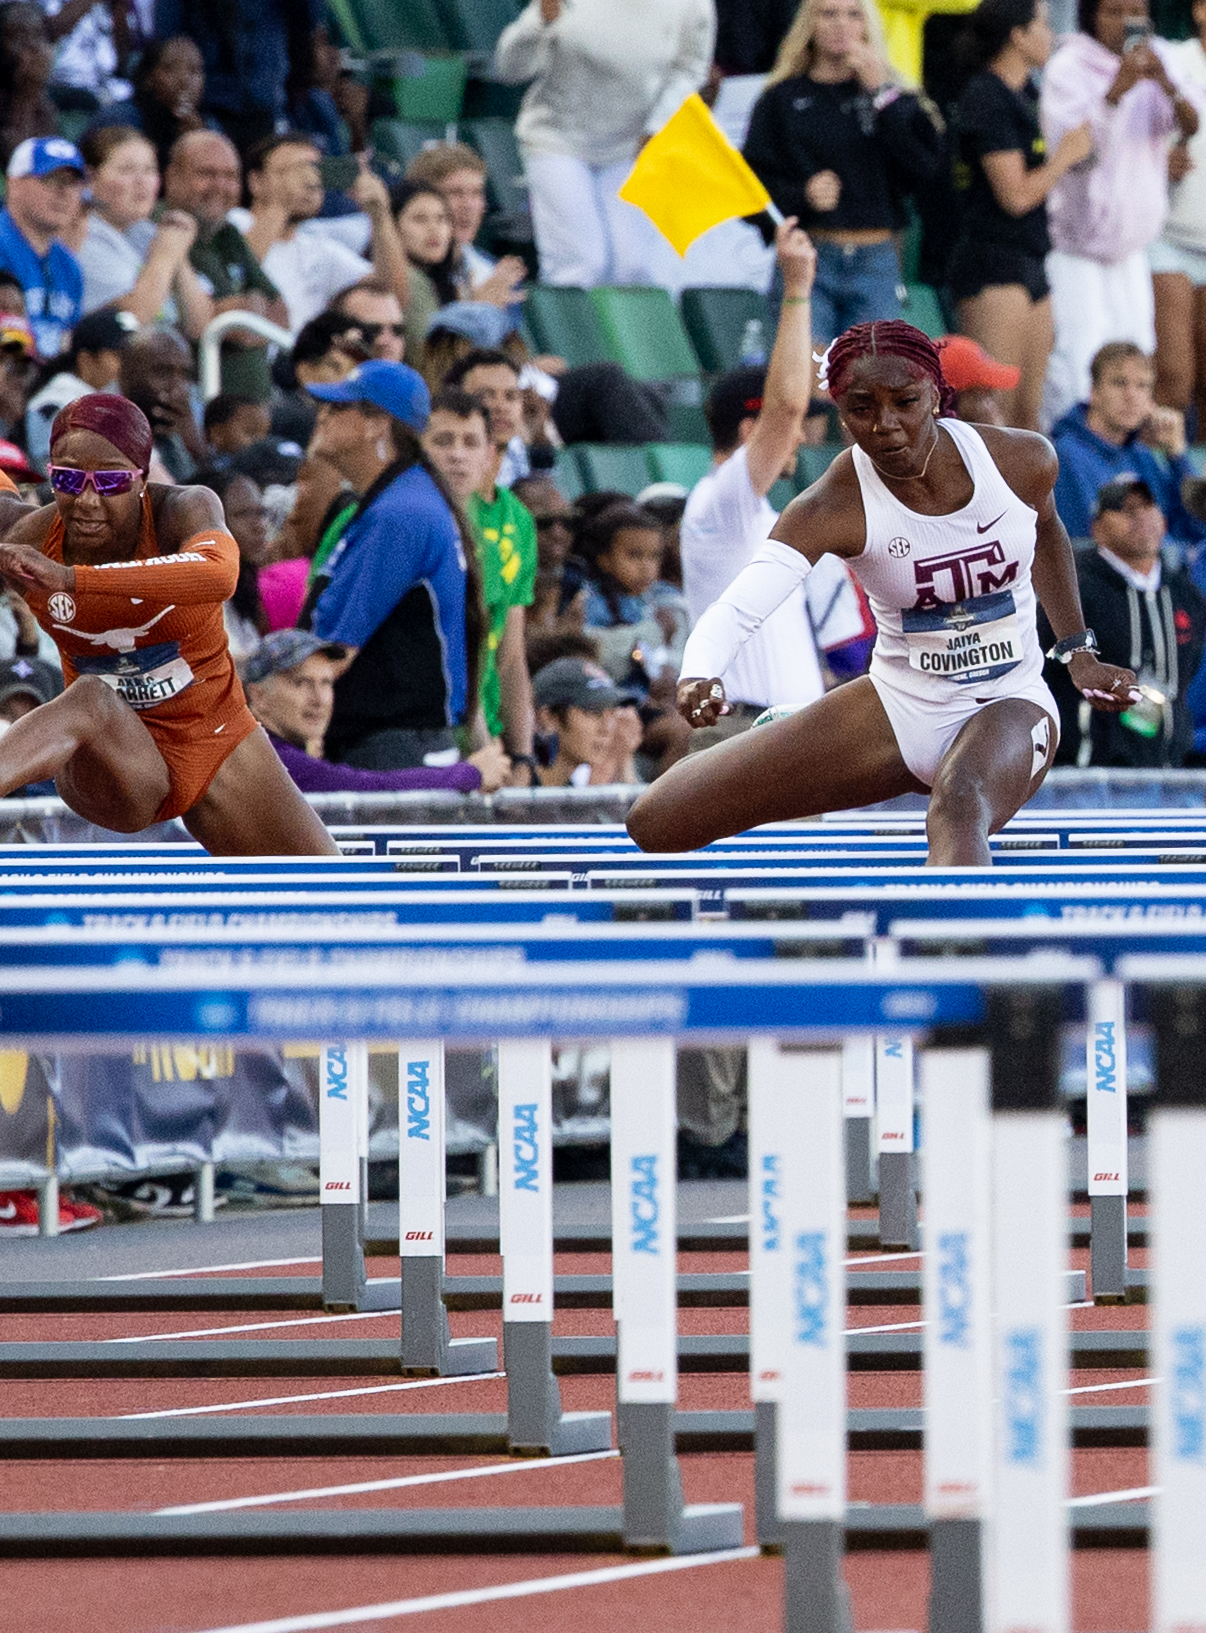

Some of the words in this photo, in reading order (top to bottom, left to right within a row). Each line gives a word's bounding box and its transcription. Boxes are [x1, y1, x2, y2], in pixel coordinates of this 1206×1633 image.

[889, 537, 911, 558] SEC
[50, 593, 76, 623] SEC
[920, 641, 1014, 671] COVINGTON
[946, 632, 981, 651] JAIYA
[326, 1040, 348, 1101] NCA
[1095, 1021, 1116, 1094] NCAA
[407, 1060, 431, 1141] NCAA
[513, 1104, 540, 1193] NCAA
[325, 1181, 351, 1190] GILL
[1094, 1172, 1120, 1182] GILL
[630, 1154, 660, 1256] NCAA
[405, 1231, 433, 1241] GILL
[510, 1293, 542, 1304] GILL
